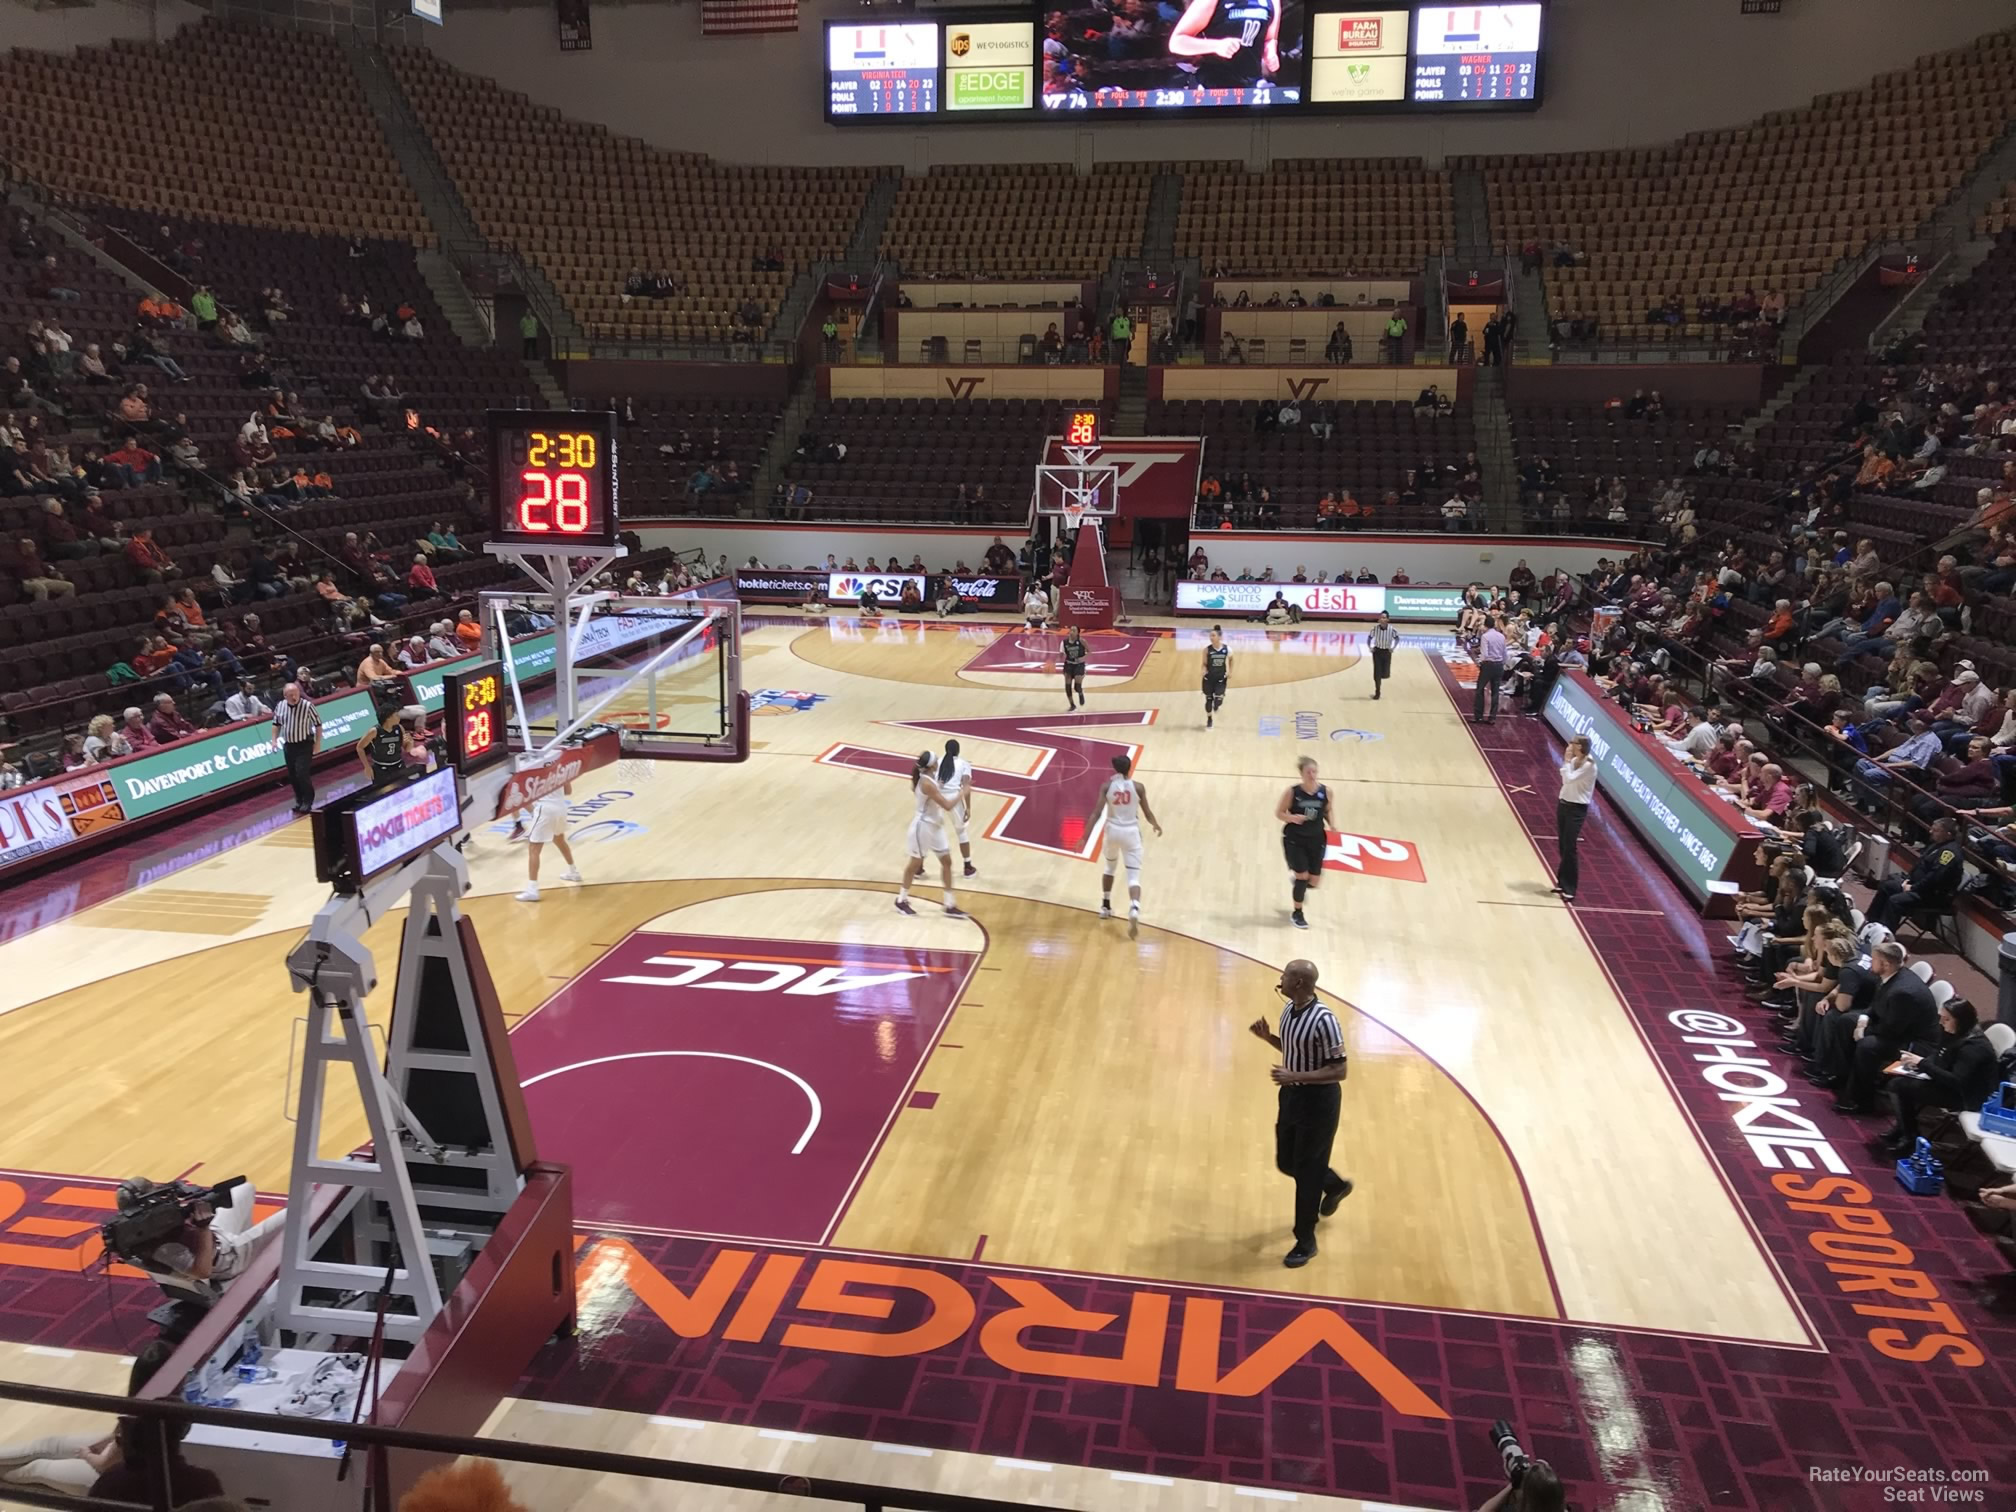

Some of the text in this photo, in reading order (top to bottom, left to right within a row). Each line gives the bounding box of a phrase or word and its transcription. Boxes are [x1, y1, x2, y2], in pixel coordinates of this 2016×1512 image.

[1353, 22, 1378, 30] FARM
[1342, 30, 1378, 39] BUREAU
[952, 40, 969, 54] ups
[1461, 56, 1492, 64] WAGNER
[1416, 64, 1531, 76] PLAYER 03 04 11 20 22
[832, 81, 858, 90] PLAYER
[870, 80, 880, 89] 02
[896, 80, 906, 89] 14
[909, 80, 919, 88] 20
[923, 79, 933, 88] 23
[960, 73, 1020, 91] the EDGE
[1416, 76, 1527, 88] FOULS 1 1 2 0 0
[832, 90, 930, 101] FOULS 1 0 0 2 1
[1156, 91, 1184, 105] 2:30
[1252, 89, 1271, 104] 21
[1358, 88, 1384, 96] game
[1415, 88, 1527, 99] POINTS 4 7 2 2 0
[832, 103, 857, 112] POINTS
[873, 102, 878, 111] 7
[899, 102, 904, 111] 2
[959, 96, 995, 104] apartment
[1043, 94, 1087, 108] VT 74
[1906, 256, 1918, 264] 14
[946, 377, 985, 399] VT
[1286, 378, 1330, 400] VT
[1074, 414, 1094, 425] 2:30
[1070, 426, 1092, 443] 28
[529, 433, 596, 468] 2:30
[1064, 452, 1185, 487] VT
[520, 472, 589, 531] 28
[738, 578, 828, 591] hokietickets.cm
[869, 579, 918, 597] CS
[1197, 584, 1261, 593] HOMEWOOD
[1228, 594, 1261, 602] SUITES
[1305, 588, 1356, 611] dish
[1394, 596, 1443, 605] DAVENPORT
[465, 676, 496, 710] 2:30
[1550, 684, 1579, 728] DAVENPORT
[466, 711, 490, 754] 28
[125, 763, 214, 800] DAVENPORT
[213, 754, 230, 770] &
[1112, 790, 1131, 805] 20
[1611, 754, 1718, 872] BUILDING WEALTH TOGETHER SINCE 1863
[1322, 834, 1409, 871] 2K
[600, 956, 928, 996] ACC
[573, 1235, 1452, 1420] VIRGIN
